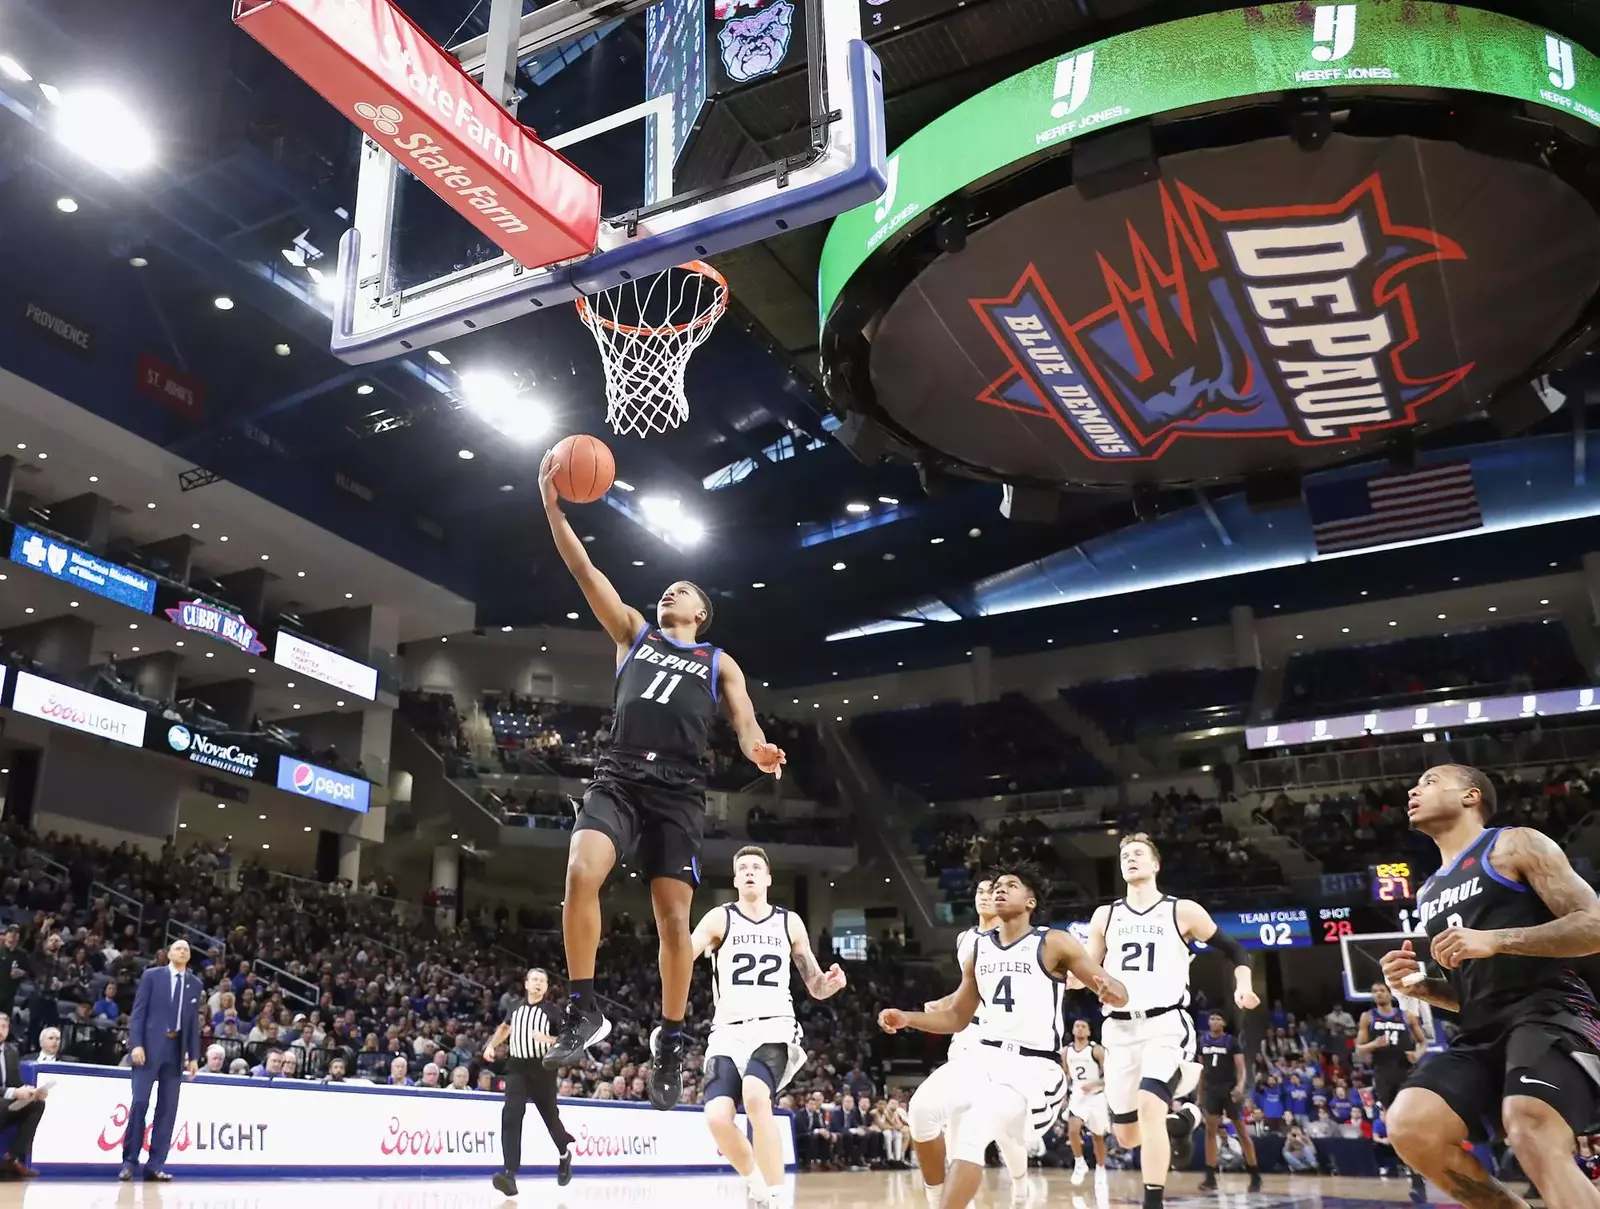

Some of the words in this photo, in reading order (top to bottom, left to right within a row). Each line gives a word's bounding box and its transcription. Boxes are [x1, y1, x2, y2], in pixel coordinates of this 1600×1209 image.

[1295, 68, 1341, 82] HERFF
[1344, 67, 1392, 80] JONES
[1035, 120, 1077, 145] HERFF
[1078, 105, 1123, 129] JONES
[26, 303, 90, 349] PROVIDENCE
[1003, 314, 1071, 376] BLUE
[1052, 383, 1132, 456] DEMONS
[183, 605, 222, 634] CUBBY
[222, 617, 253, 649] BEAR
[640, 670, 683, 705] 11
[41, 694, 87, 724] Coors
[88, 715, 128, 736] LIGHT
[189, 752, 254, 778] REHABILITATION
[190, 733, 259, 769] NovaCare
[315, 776, 355, 800] pepsi
[1238, 911, 1270, 925] TEAM
[1270, 909, 1307, 923] FOULS
[1319, 907, 1351, 920] SHOT
[732, 933, 782, 948] BUTLER
[1117, 924, 1165, 937] BUTLER
[1259, 922, 1293, 946] 02
[731, 953, 782, 988] 22
[979, 961, 1033, 976] BUTLER
[1121, 942, 1156, 972] 21
[991, 976, 1015, 1013] 4
[1075, 1066, 1087, 1081] 2
[196, 1121, 268, 1151] LIGHT
[381, 1116, 444, 1156] Coors
[445, 1130, 495, 1154] LIGHT
[576, 1123, 621, 1157] Coors
[621, 1135, 658, 1156] LIGHT
